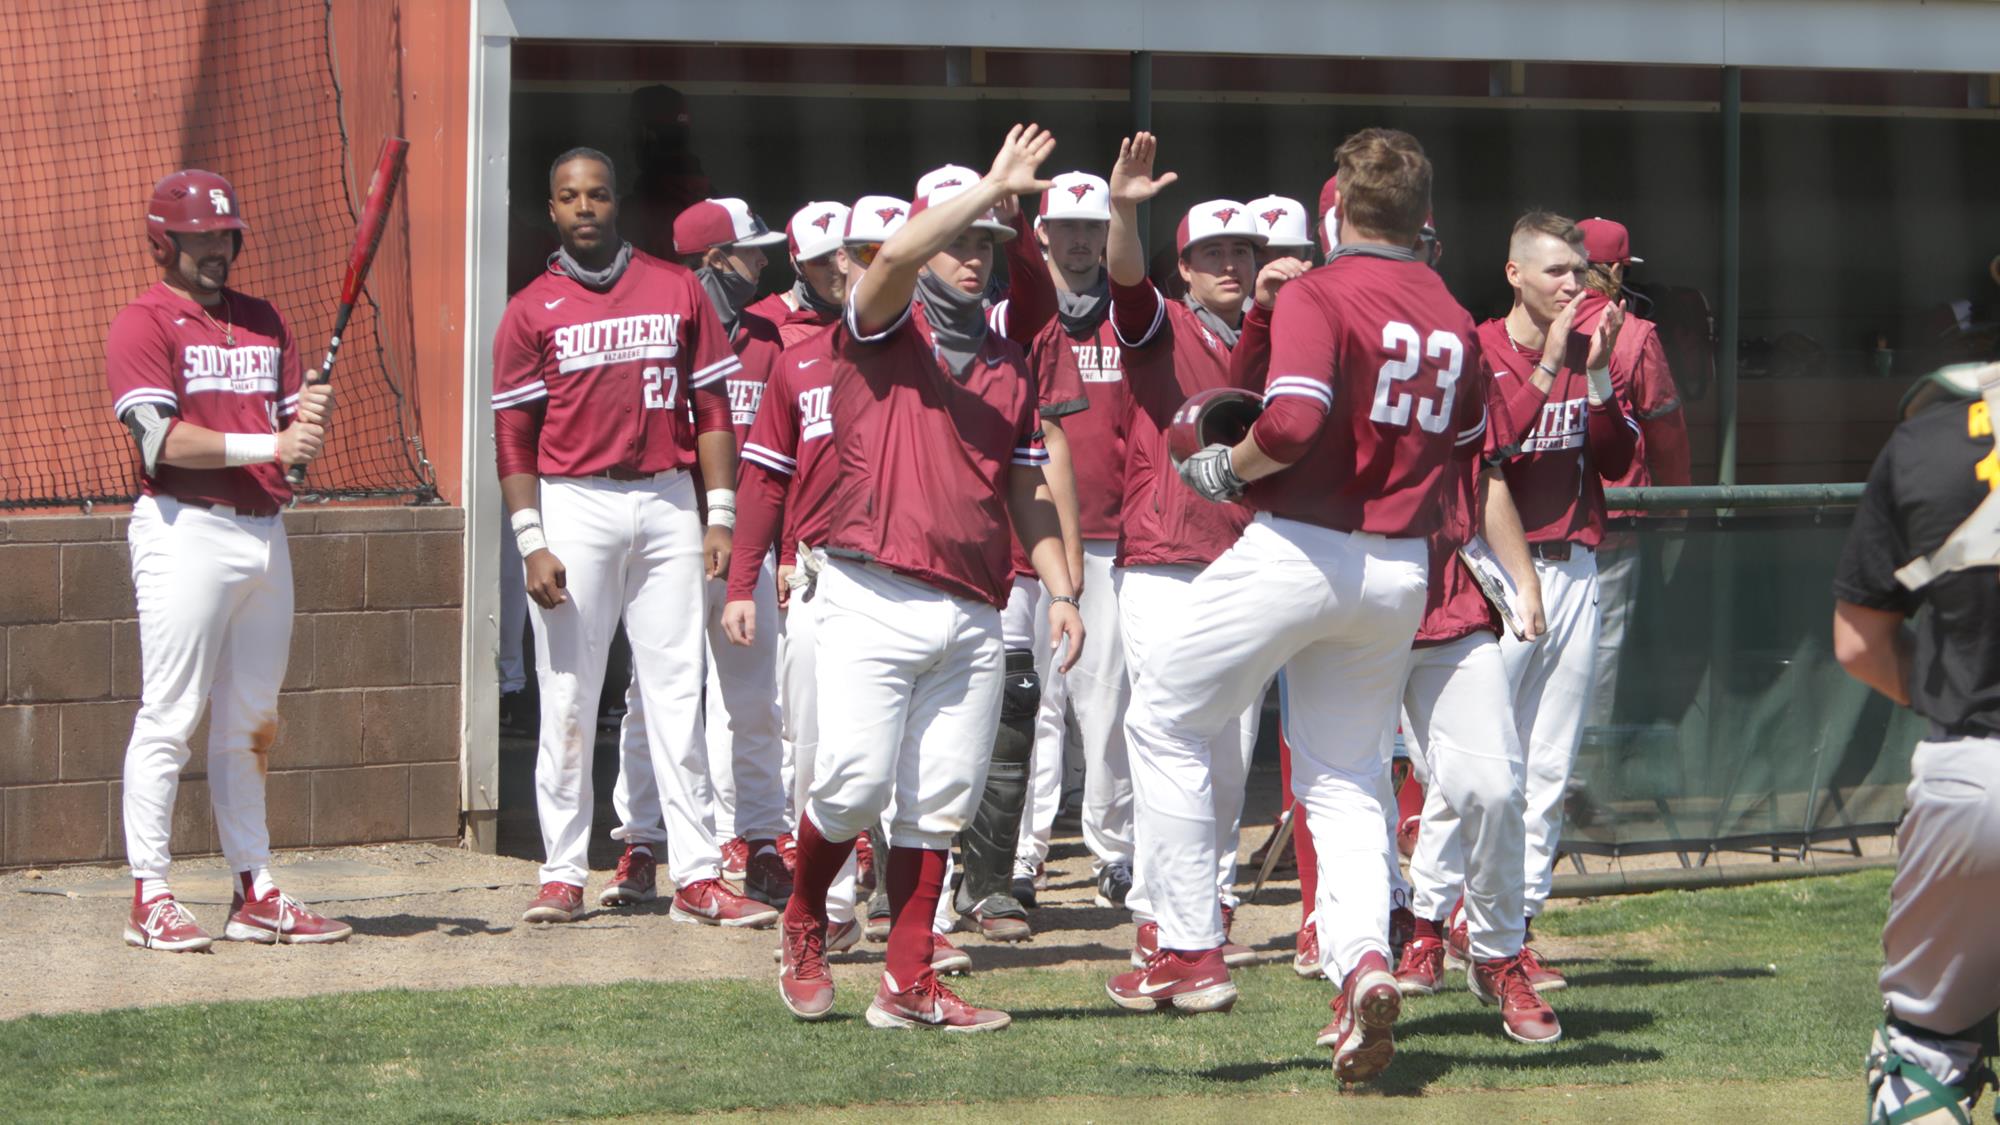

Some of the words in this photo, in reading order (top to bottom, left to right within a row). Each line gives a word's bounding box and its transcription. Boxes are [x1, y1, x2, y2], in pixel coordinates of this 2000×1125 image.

[555, 314, 681, 360] SOUTHERN
[643, 366, 678, 409] 27
[726, 380, 767, 411] HER
[1369, 320, 1464, 434] 23
